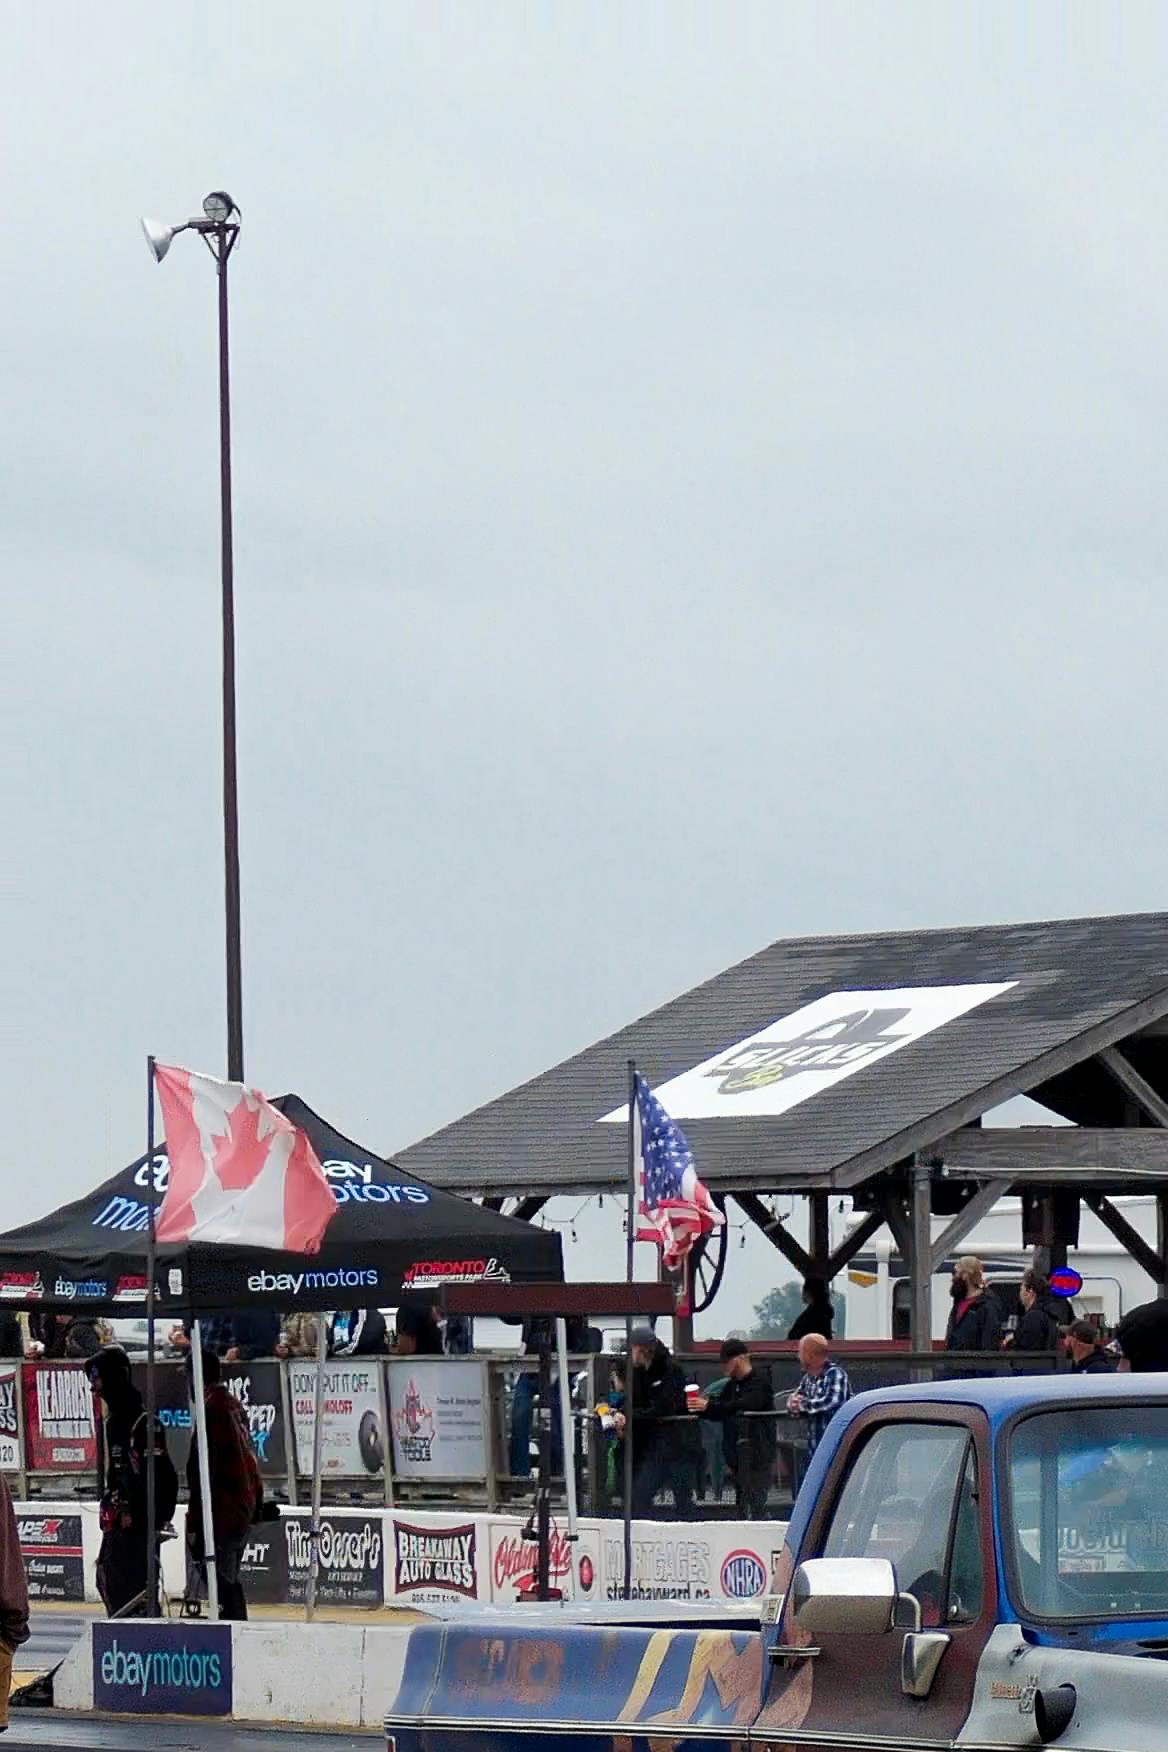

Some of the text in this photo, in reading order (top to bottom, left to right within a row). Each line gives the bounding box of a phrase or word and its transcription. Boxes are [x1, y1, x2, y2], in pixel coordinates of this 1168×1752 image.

[333, 1181, 429, 1204] otors
[413, 1260, 485, 1275] TORONTO
[399, 1531, 473, 1564] BREAKAWAY
[400, 1560, 474, 1588] AUTO GLASS
[726, 1559, 763, 1598] NHRA
